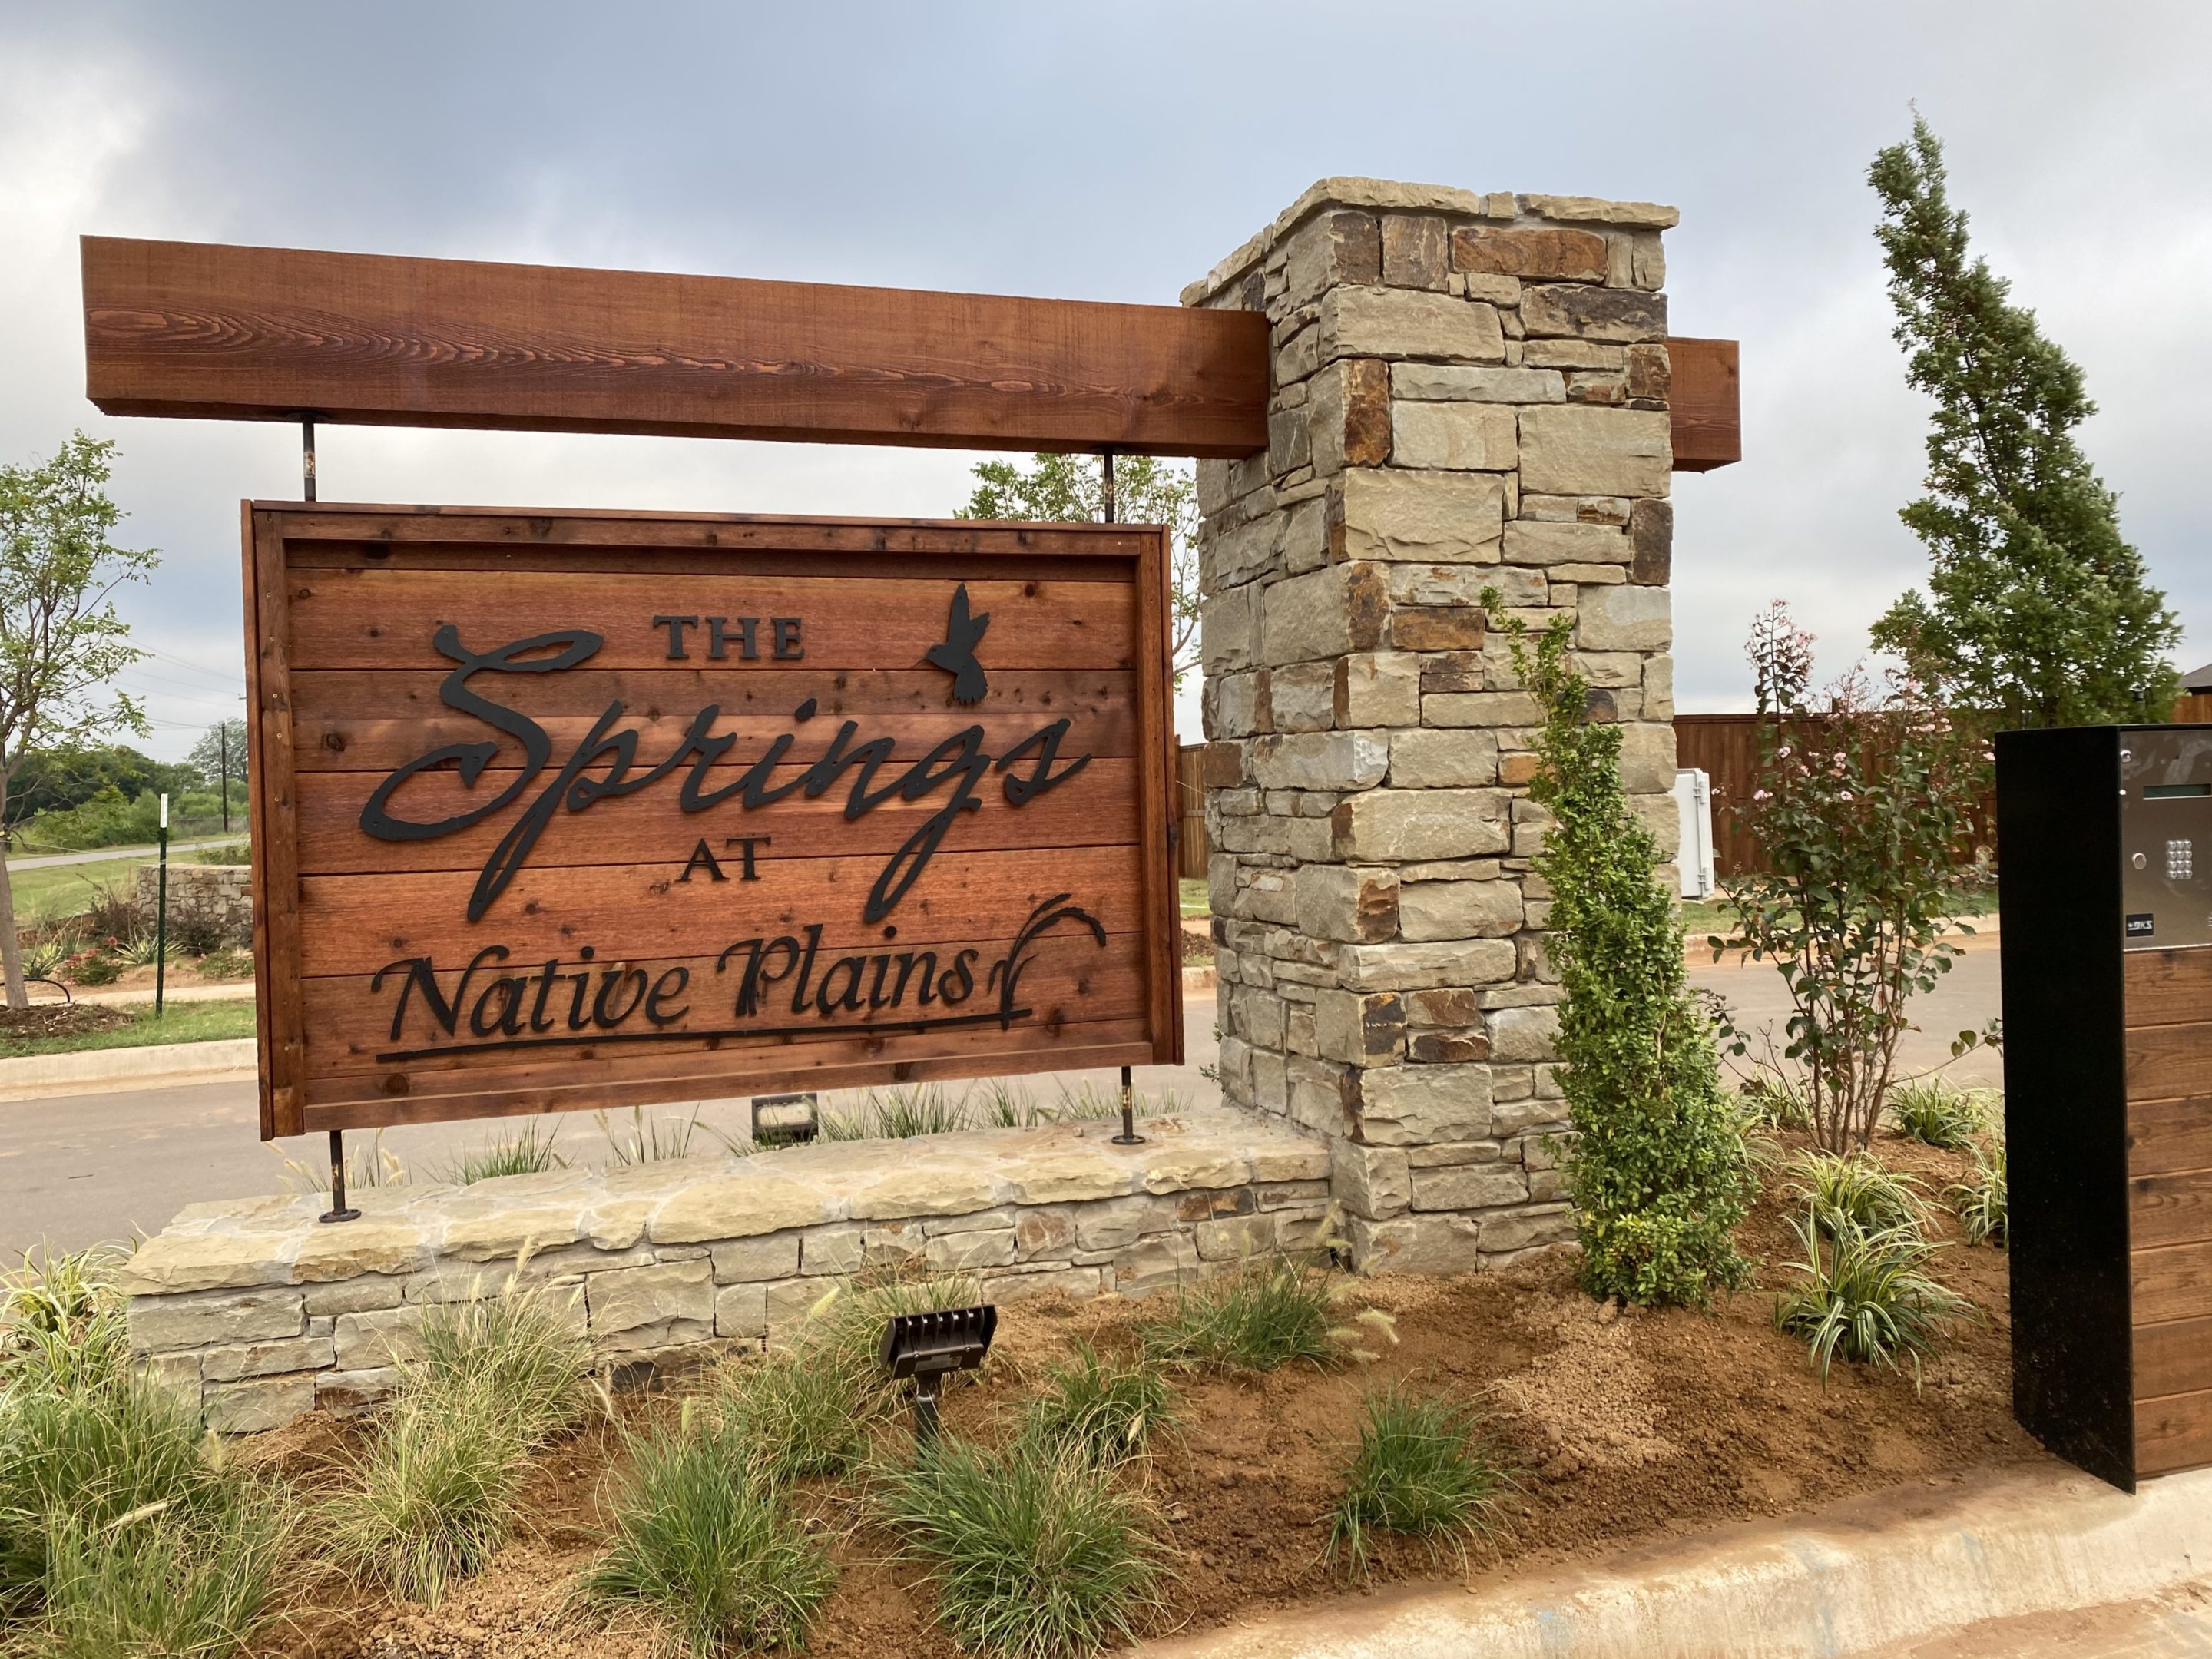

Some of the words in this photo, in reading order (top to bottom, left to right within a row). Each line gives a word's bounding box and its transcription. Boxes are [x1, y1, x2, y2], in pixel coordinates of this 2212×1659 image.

[653, 616, 805, 661] THE
[359, 624, 1091, 921] Springs
[676, 837, 771, 882] AT
[371, 945, 689, 1041] Native
[716, 924, 979, 1018] Plains
